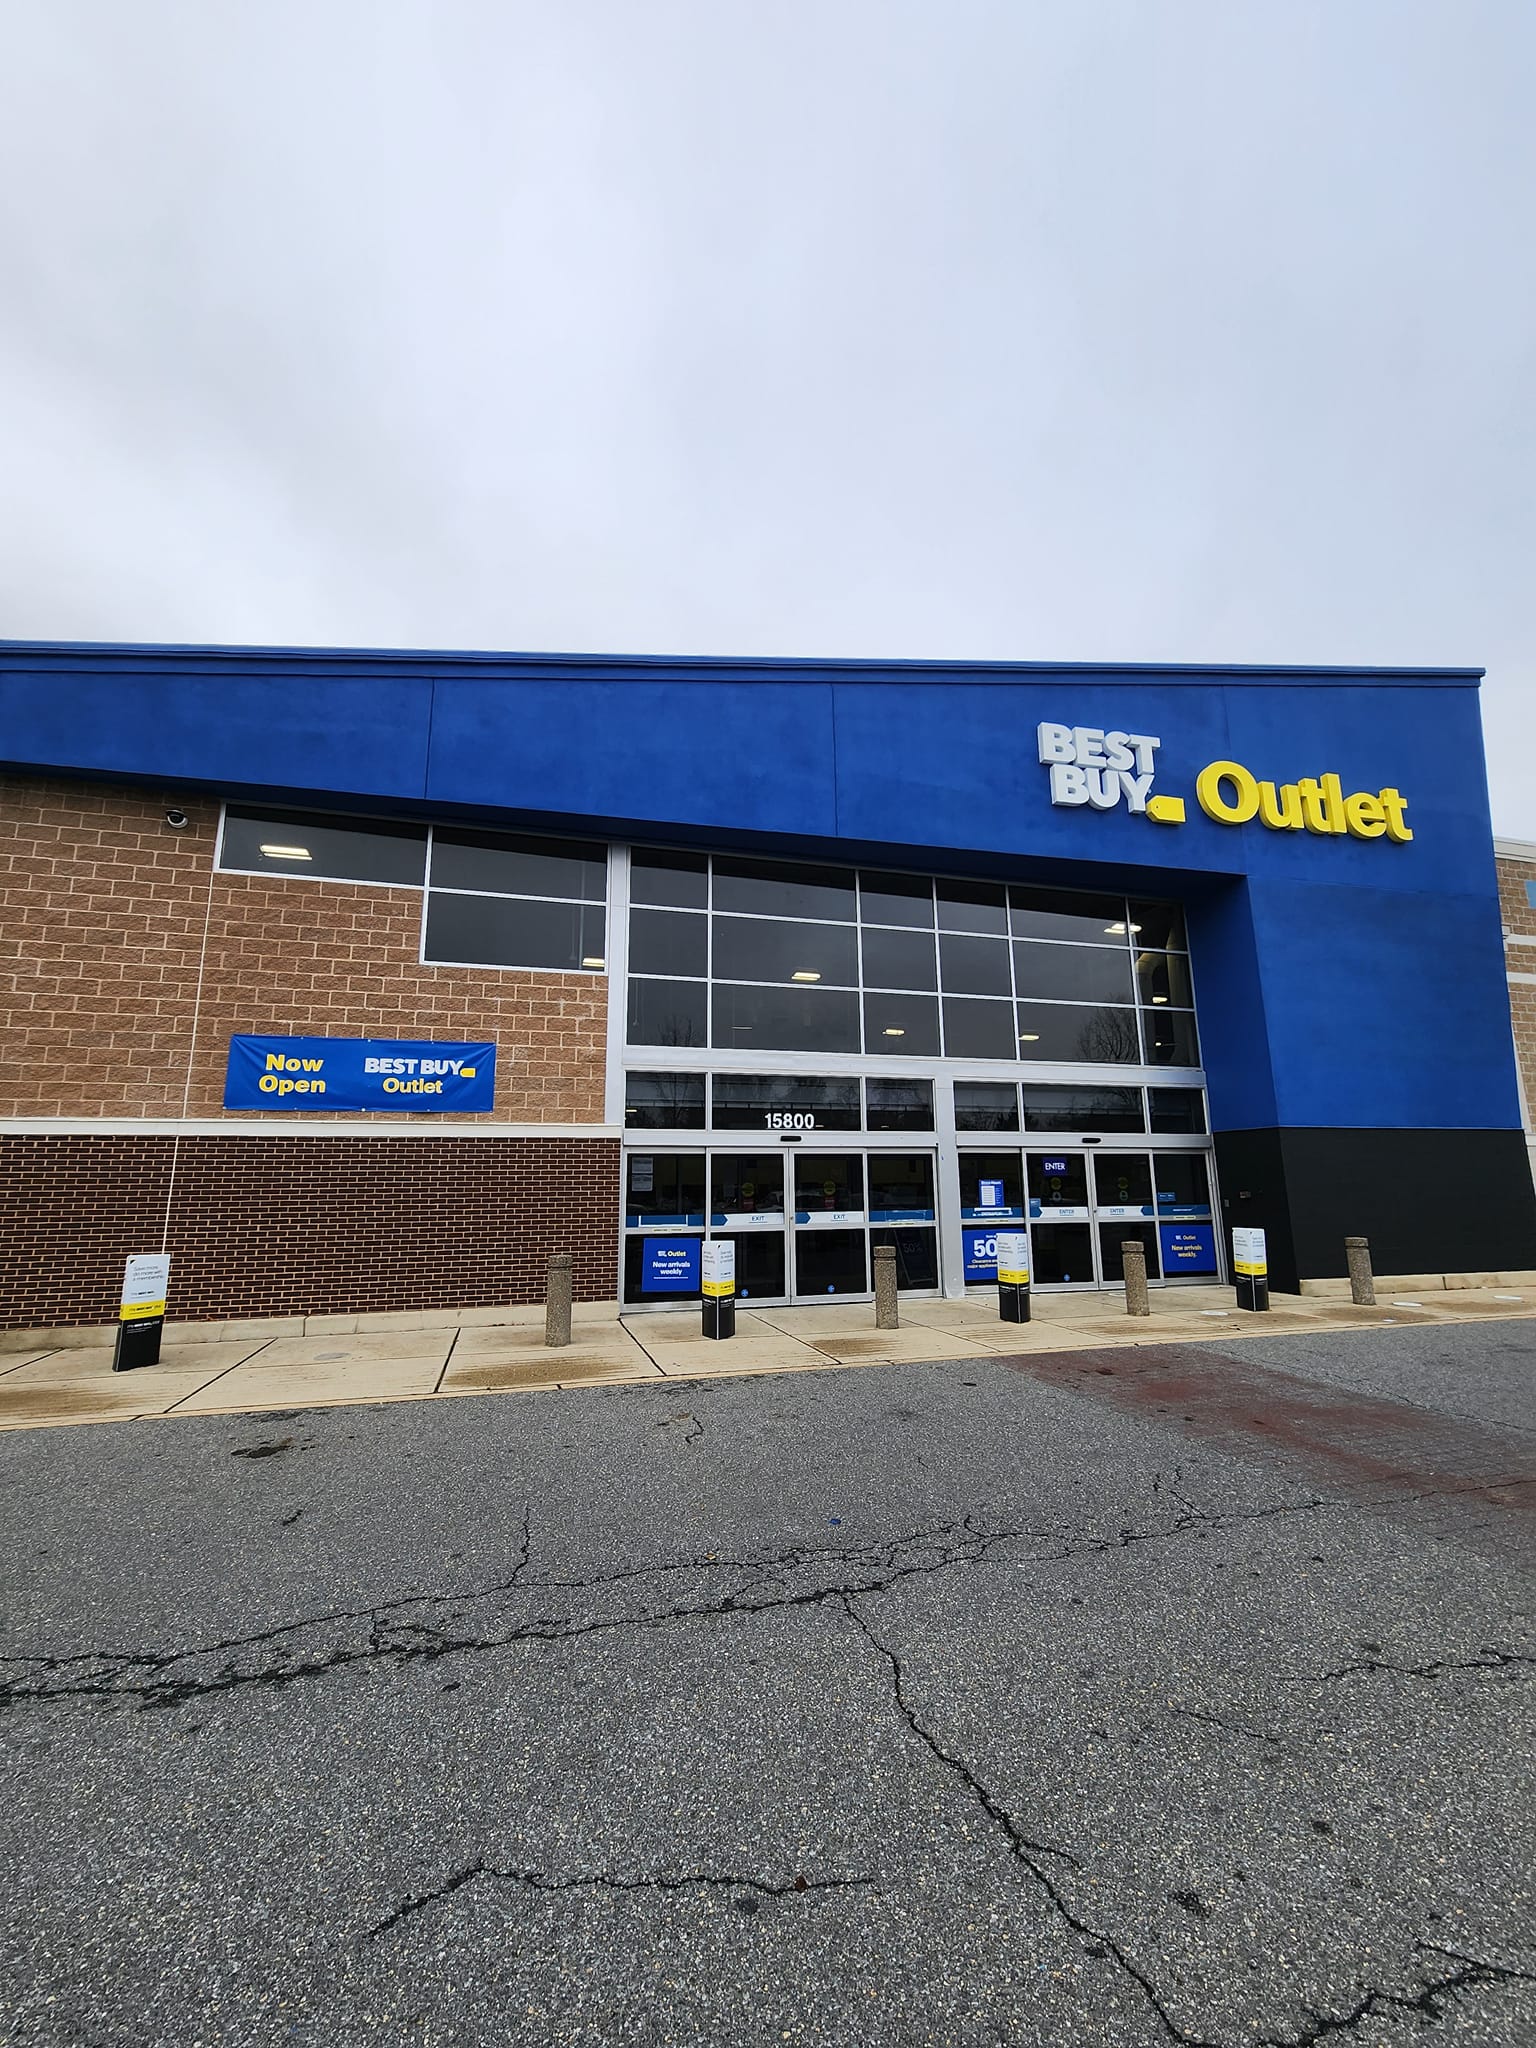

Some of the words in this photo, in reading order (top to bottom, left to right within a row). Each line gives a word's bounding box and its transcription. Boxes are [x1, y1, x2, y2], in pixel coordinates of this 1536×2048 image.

[1037, 721, 1161, 775] BEST
[1050, 763, 1155, 814] BUY
[1195, 760, 1413, 843] Outlet
[266, 1053, 324, 1072] Now
[364, 1057, 419, 1075] BEST
[420, 1059, 464, 1075] BUY
[258, 1074, 326, 1096] Open
[382, 1077, 443, 1094] Outlet
[764, 1113, 815, 1130] 15800
[1045, 1163, 1066, 1171] ENTER
[660, 1268, 683, 1276] weekly
